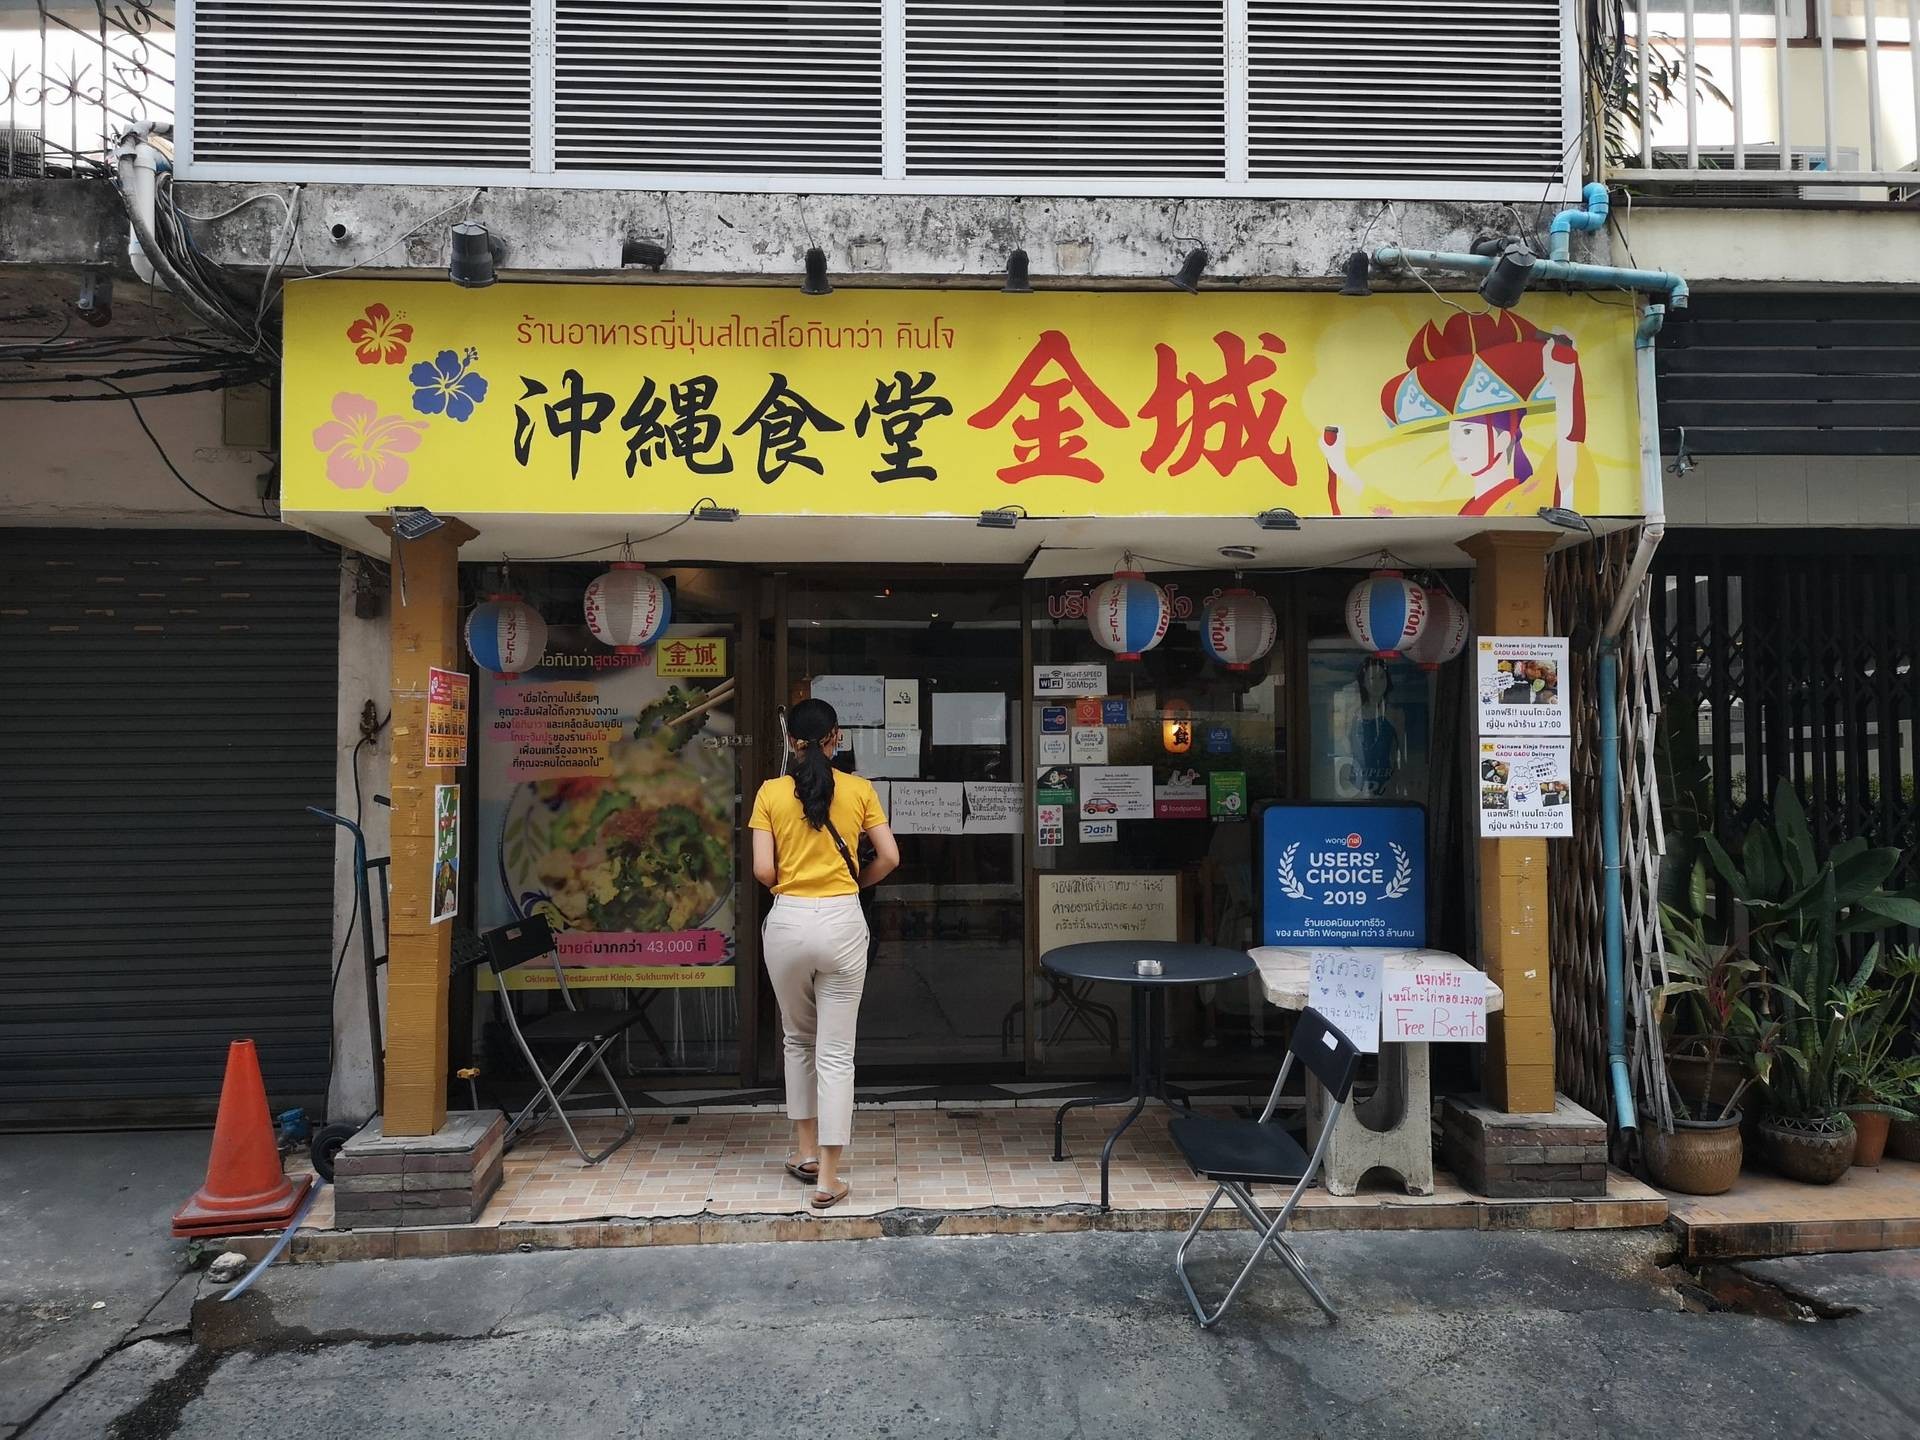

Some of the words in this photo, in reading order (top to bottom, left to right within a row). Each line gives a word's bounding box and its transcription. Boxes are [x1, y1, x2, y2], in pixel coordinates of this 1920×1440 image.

[517, 310, 883, 355] ร้านอาหารญี่ปุ่นสไตล์โอกินาว่า
[897, 314, 955, 349] คินโจ
[514, 368, 954, 484] 沖縄食堂
[966, 330, 1298, 487] 金城
[662, 641, 717, 666] 金城
[1067, 681, 1098, 690] 50Mbps
[1083, 824, 1113, 834] Dash
[1541, 822, 1564, 830] 17:00
[1325, 835, 1360, 846] wongnai
[1306, 869, 1384, 884] CHOICE
[1323, 891, 1367, 906] 2019
[1304, 916, 1386, 927] ร้านยอดนิยมจากรีวิว
[1293, 928, 1320, 938] สมาชิก
[1322, 929, 1360, 939] Wongnai
[1361, 928, 1378, 938] กว่า
[1378, 929, 1385, 937] 3
[1386, 928, 1415, 938] ล้านคน
[647, 939, 694, 953] 43,000
[636, 972, 679, 982] Sukhumvit
[694, 972, 706, 981] 69
[1415, 972, 1461, 987] แจกฟรี!!
[1396, 1008, 1425, 1036] Free
[1433, 1007, 1485, 1038] Bento
